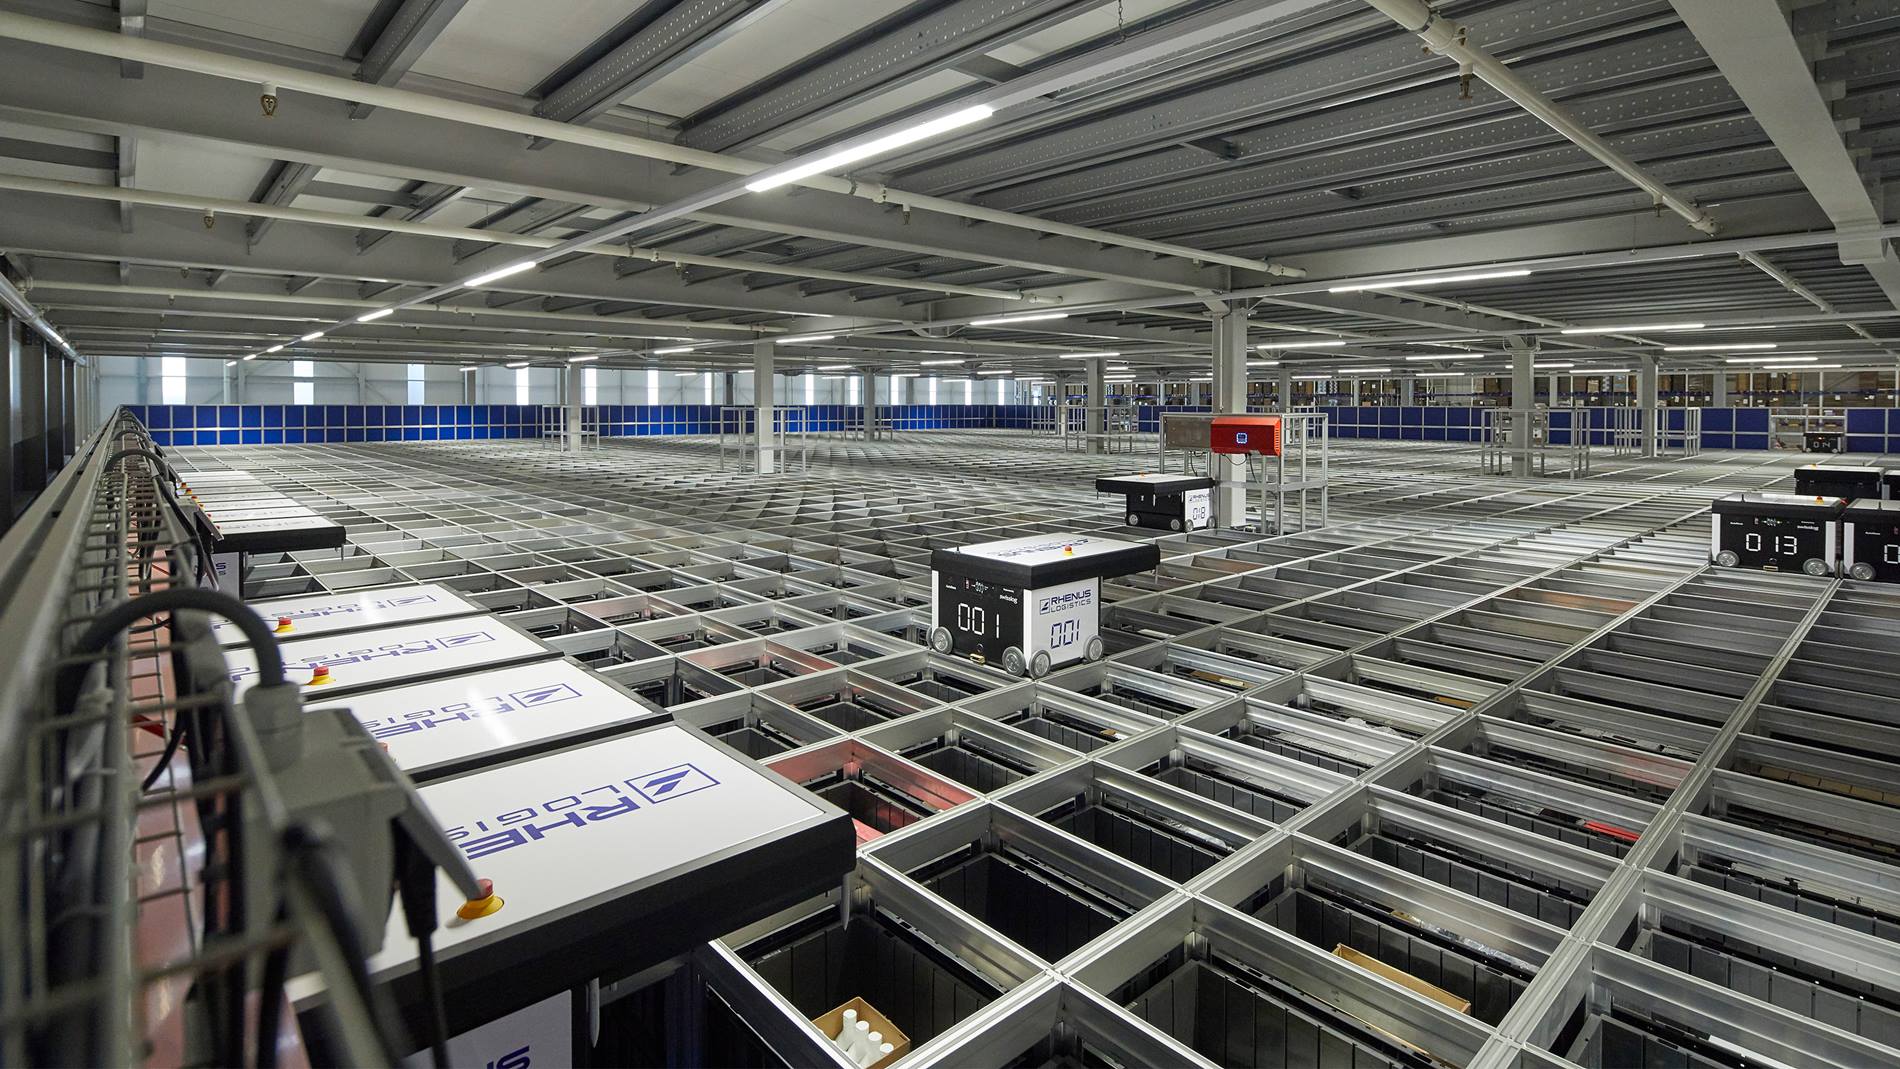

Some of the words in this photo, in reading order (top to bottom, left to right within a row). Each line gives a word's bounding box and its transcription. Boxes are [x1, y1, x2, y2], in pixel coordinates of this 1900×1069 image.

[1192, 506, 1206, 520] 018
[1746, 533, 1798, 556] 013
[1051, 588, 1092, 606] RHENUS
[1051, 598, 1092, 614] LOGISTICS
[957, 602, 1000, 639] 001
[1050, 618, 1081, 650] 001
[456, 795, 641, 861] RHE
